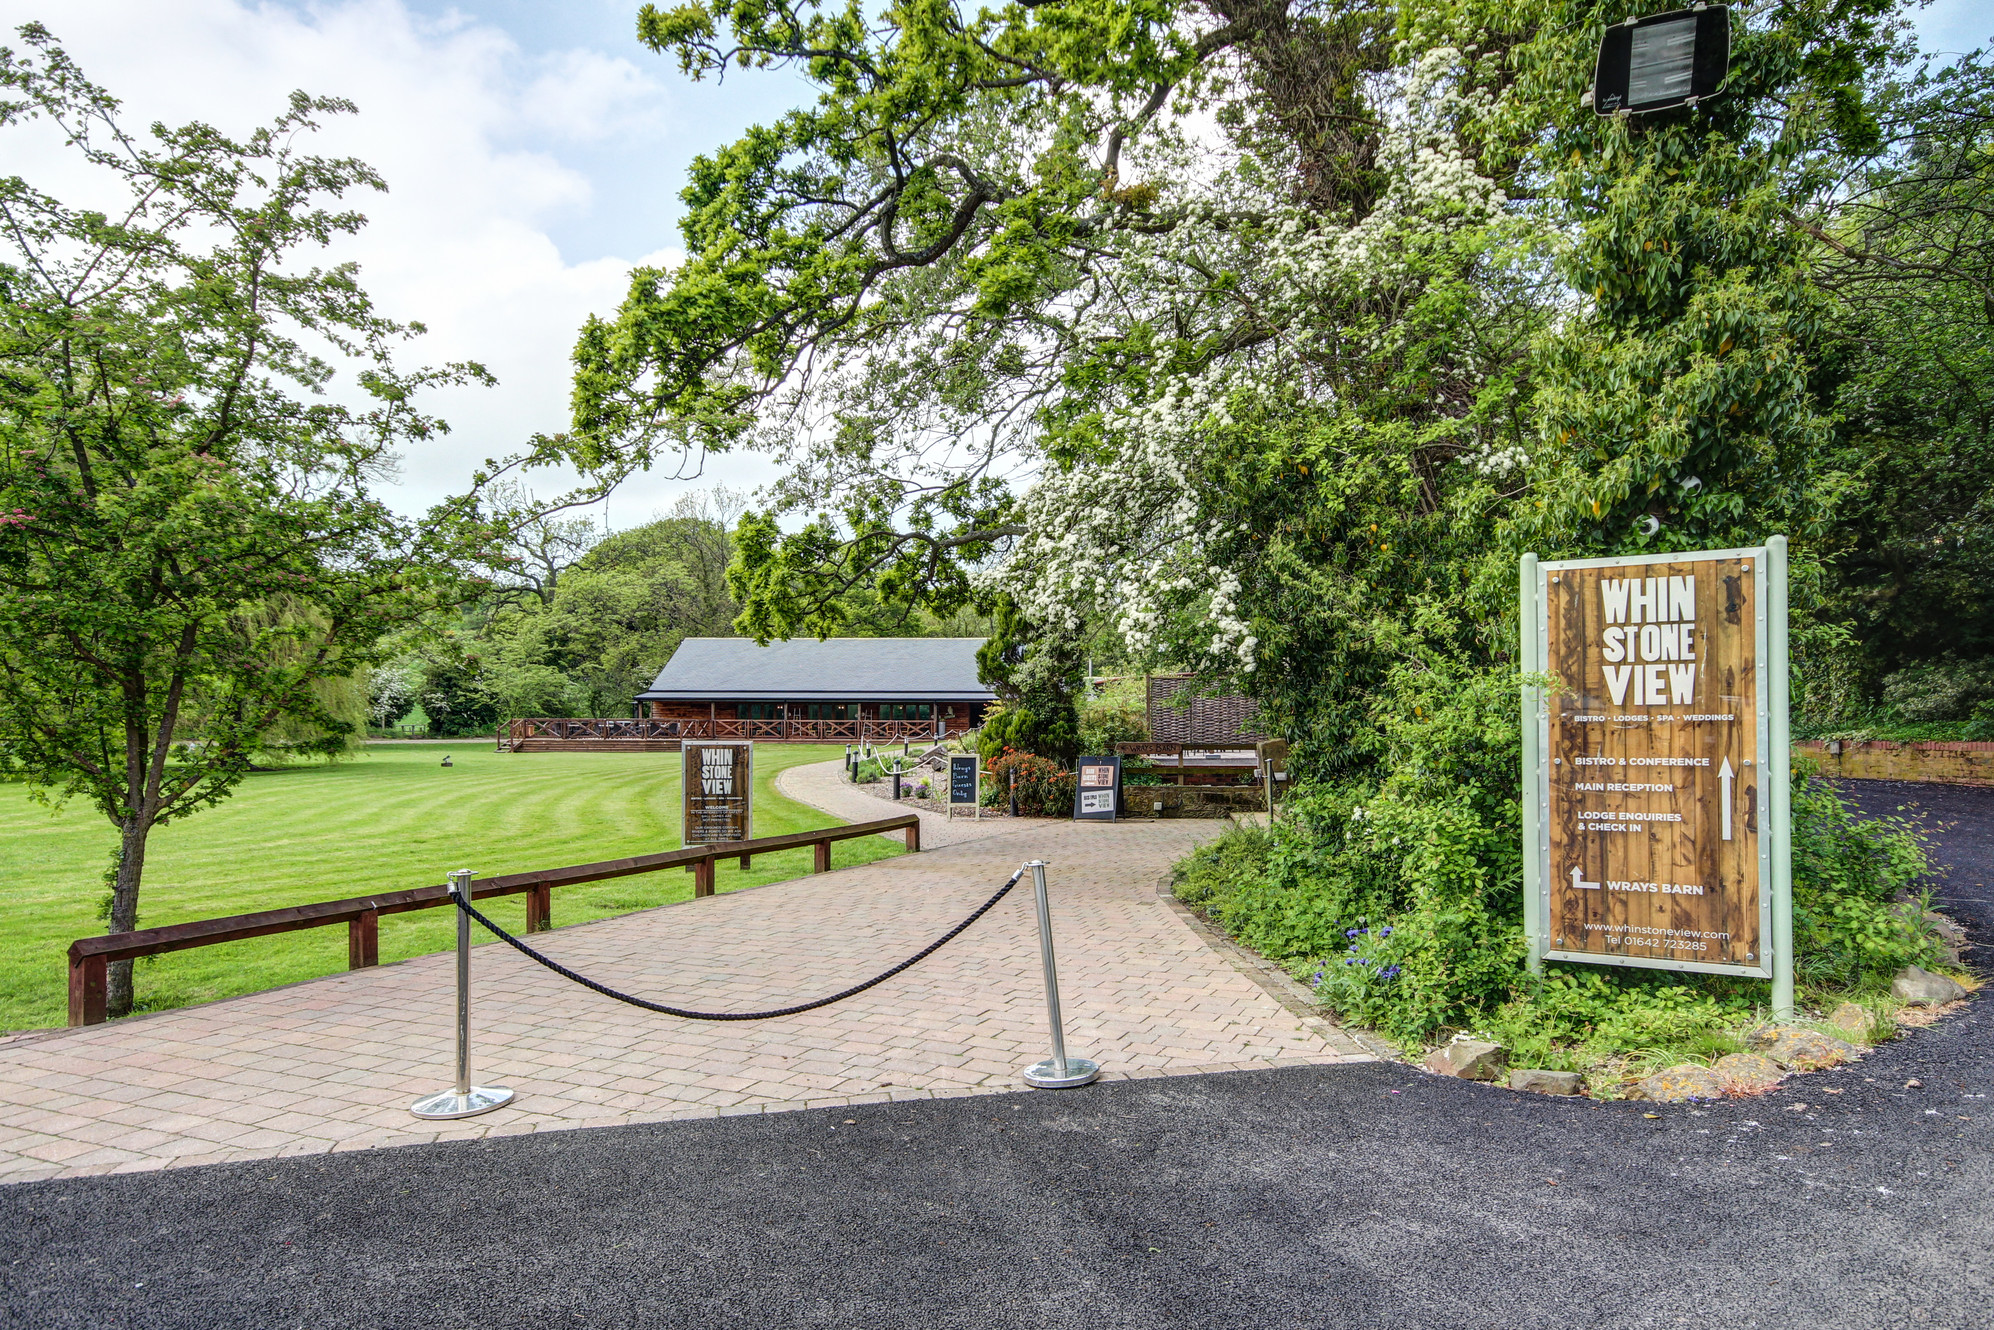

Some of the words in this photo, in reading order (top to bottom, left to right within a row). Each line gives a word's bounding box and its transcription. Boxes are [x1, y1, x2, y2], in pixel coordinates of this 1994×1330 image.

[1601, 575, 1696, 624] WHIN
[1602, 624, 1696, 663] STONE
[1602, 663, 1696, 706] VIEW
[1656, 714, 1674, 722] SPA
[1156, 743, 1177, 752] BARN
[701, 748, 733, 765] WHIN
[1575, 757, 1616, 766] BISTRO
[1618, 757, 1626, 766] &
[1629, 757, 1710, 766] CONFERENCE
[701, 765, 733, 779] STONE
[701, 779, 733, 795] VIEW
[1575, 783, 1604, 791] MAIN
[1607, 783, 1673, 792] RECEPTION
[1577, 812, 1616, 820] LODGE
[1619, 812, 1682, 822] ENQUIRIES
[1578, 823, 1585, 831] &
[1588, 823, 1627, 832] CHECK
[1629, 823, 1642, 832] IN
[1606, 880, 1658, 893] WRAYS
[1661, 883, 1704, 896] BARN
[1584, 922, 1730, 940] www.whinstoneview.com
[1605, 935, 1621, 945] Tel
[1624, 936, 1660, 948] 01642
[1663, 939, 1707, 951] 723285
